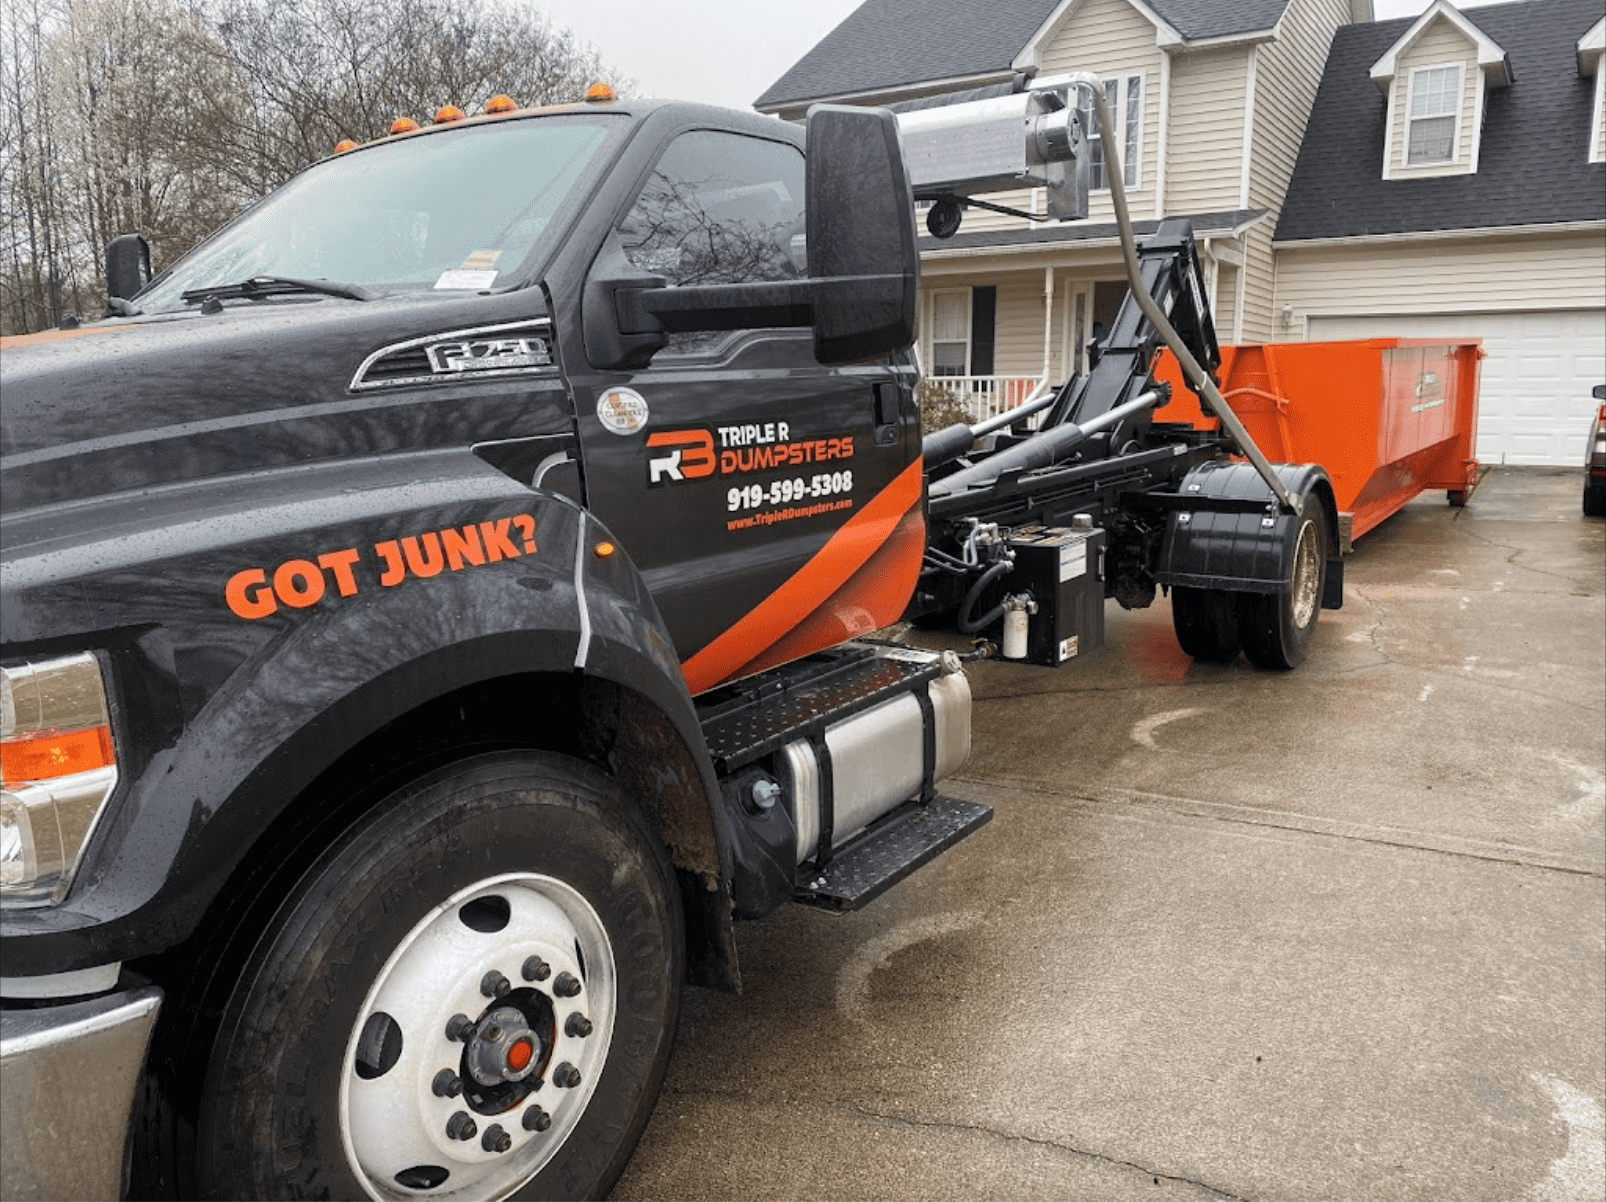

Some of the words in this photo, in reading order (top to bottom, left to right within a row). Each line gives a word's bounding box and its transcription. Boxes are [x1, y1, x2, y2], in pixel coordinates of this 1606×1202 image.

[718, 423, 775, 447] TRIPLE
[778, 421, 789, 441] R
[721, 436, 854, 474] DUMPSTERS
[727, 470, 853, 511] 919-599-5308
[727, 499, 853, 531] www.TripleRDumpsters.com
[225, 548, 360, 620] GOT
[375, 513, 537, 587] JUNK?
